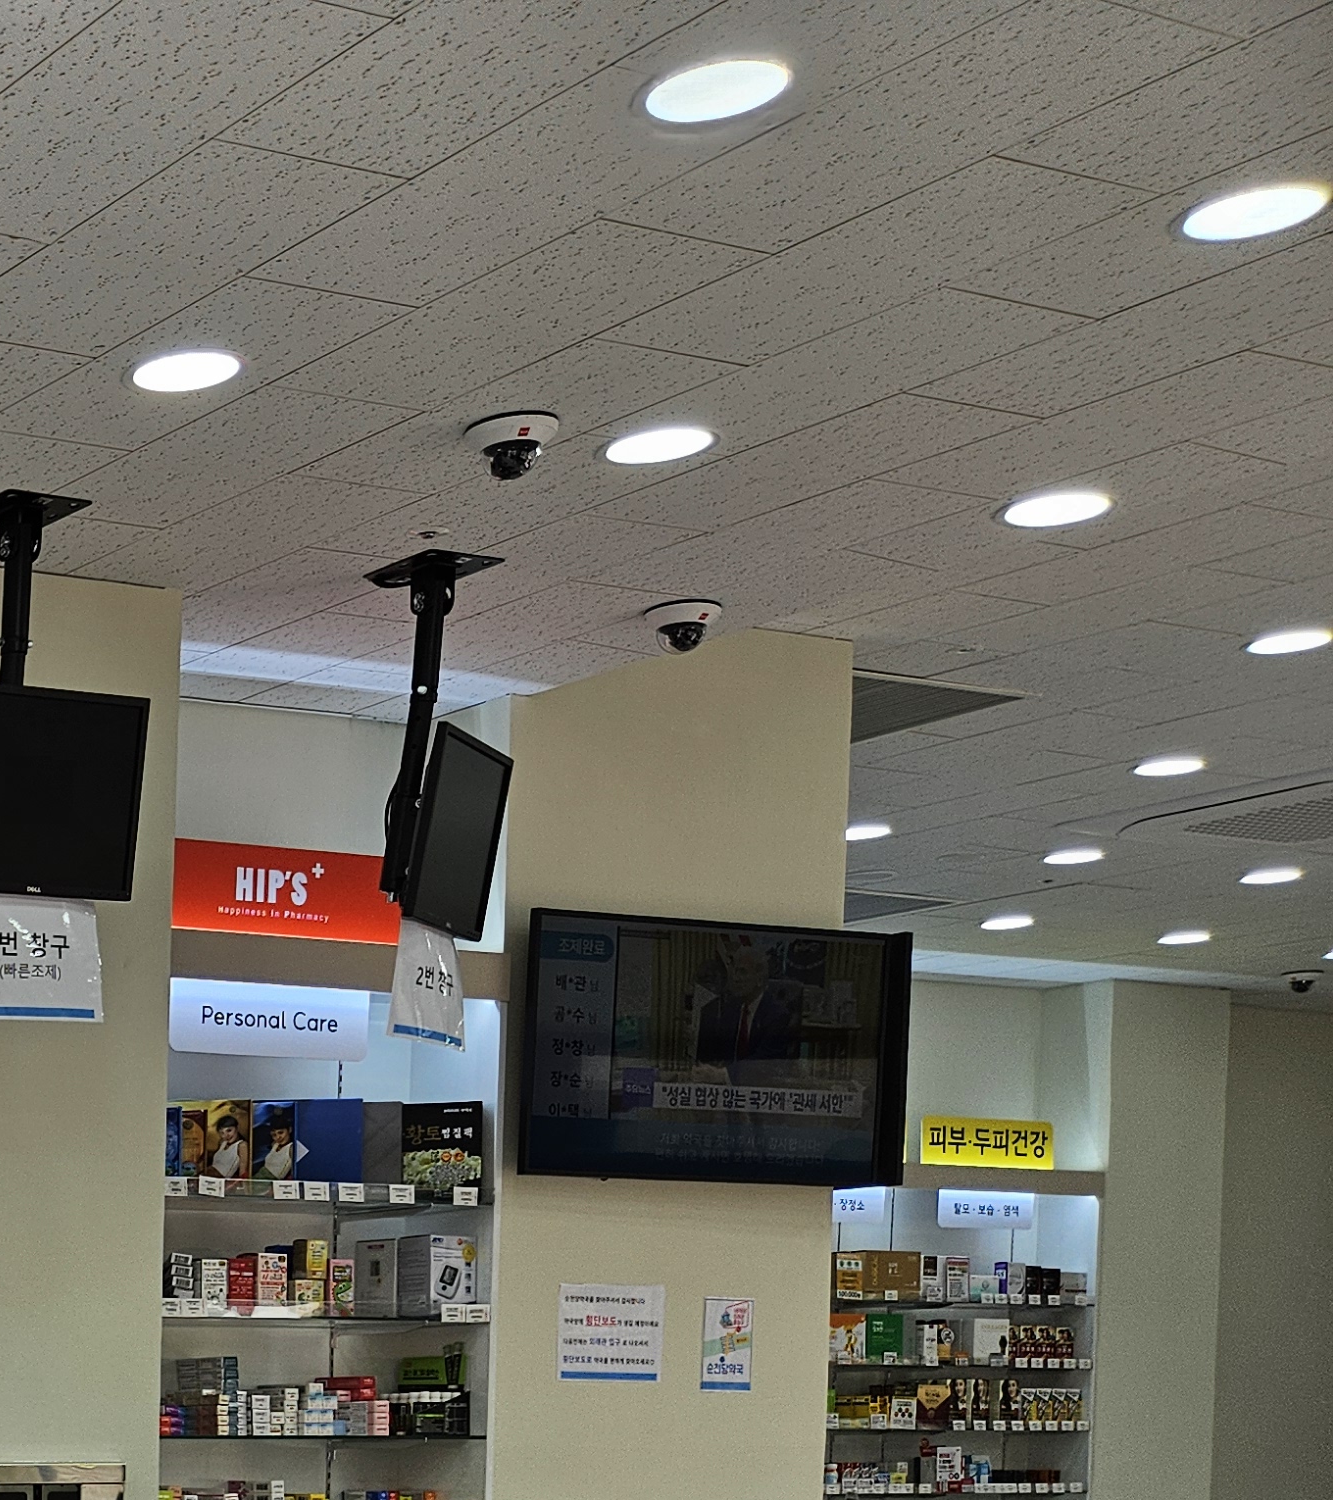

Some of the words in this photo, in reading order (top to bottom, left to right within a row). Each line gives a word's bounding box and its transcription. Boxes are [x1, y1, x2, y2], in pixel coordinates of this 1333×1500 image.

[235, 867, 308, 906] HIP'S
[217, 905, 267, 917] Happiness
[284, 910, 330, 924] Pharmacy
[30, 931, 70, 960] 창구
[558, 938, 606, 956] 조제완료
[0, 963, 62, 981] (빠른조제)
[415, 966, 434, 990] 2번
[201, 1005, 286, 1030] Personal
[293, 1012, 338, 1033] Care
[695, 1088, 720, 1108] 협상
[978, 1204, 994, 1216] 보습
[1003, 1205, 1019, 1217] 염색
